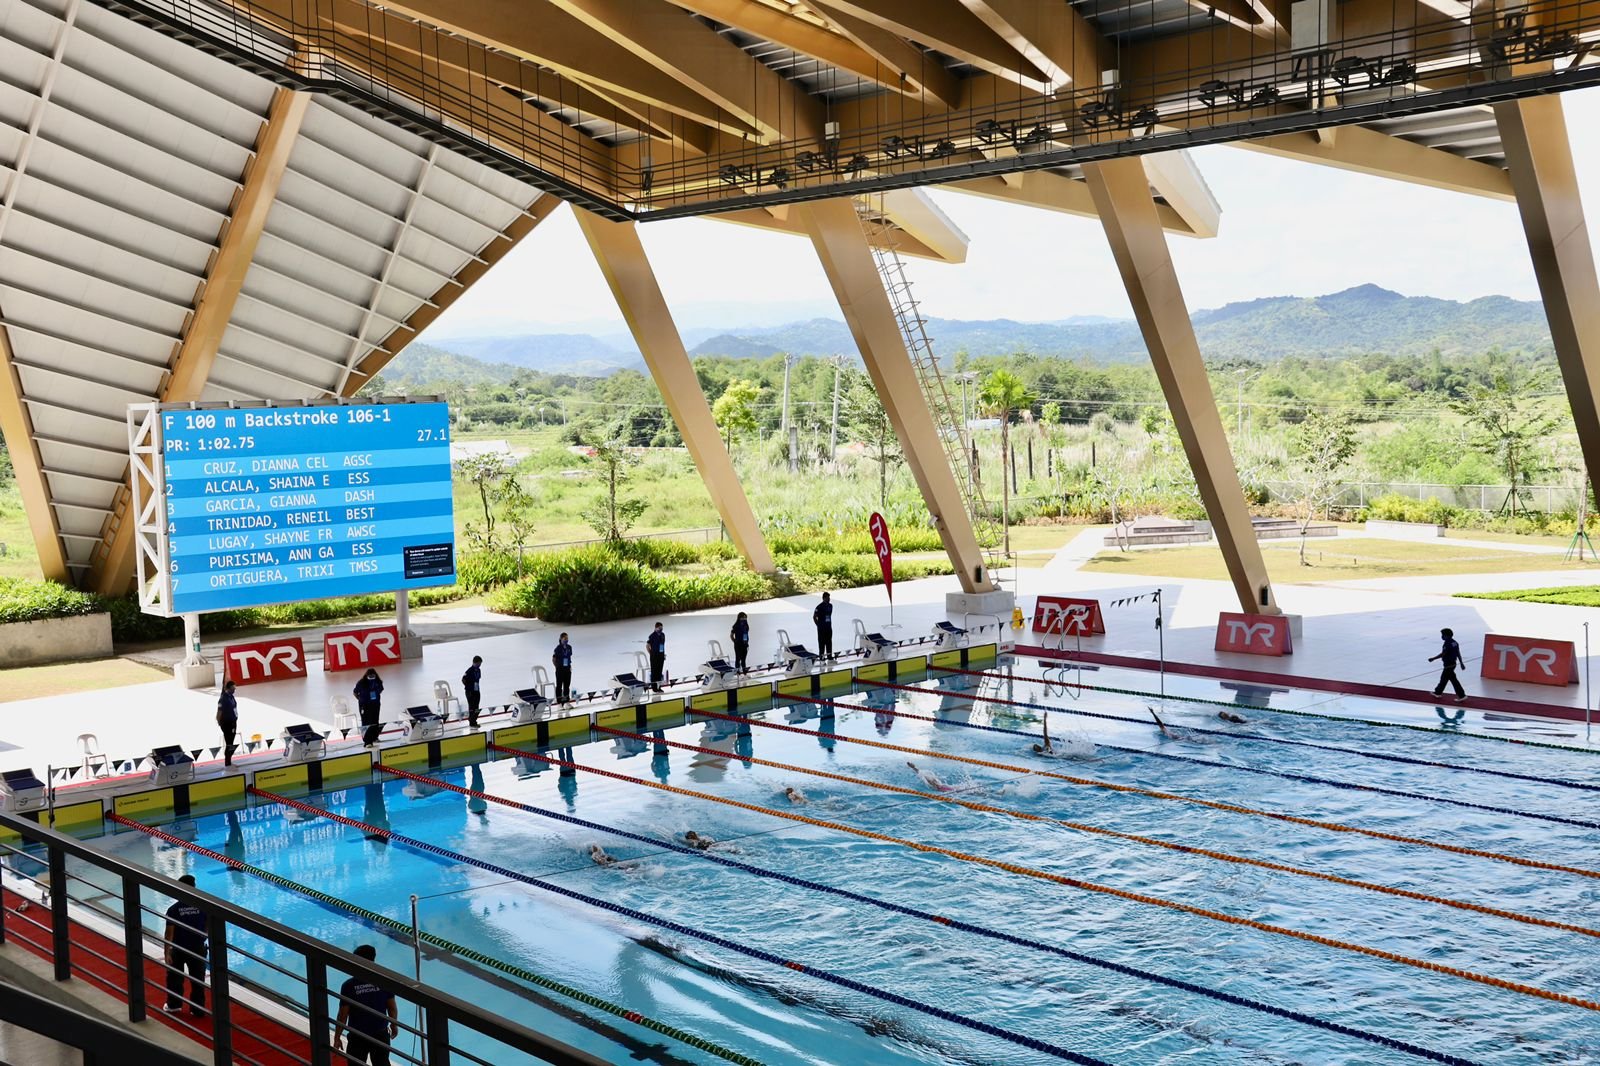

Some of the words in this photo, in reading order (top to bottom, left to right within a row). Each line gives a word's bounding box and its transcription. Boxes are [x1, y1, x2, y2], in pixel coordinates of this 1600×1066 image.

[165, 415, 175, 430] F
[185, 414, 216, 430] 100
[225, 415, 236, 428] m
[245, 410, 338, 427] Backstroke
[347, 408, 391, 423] 106-1
[166, 439, 190, 452] PR:
[198, 436, 255, 451] 1:02.75
[417, 428, 447, 442] 27.1
[164, 465, 173, 477] 1
[203, 461, 243, 476] CRUZ,
[252, 458, 300, 472] DIANNA
[306, 456, 329, 469] CEL
[343, 454, 373, 467] AGSC
[165, 484, 175, 496] 2
[205, 479, 260, 494] ALCALA,
[269, 475, 316, 490] SHAINA
[322, 474, 330, 486] E
[348, 472, 370, 485] ESS
[167, 503, 176, 515] 3
[206, 498, 261, 513] GARCIA,
[269, 493, 317, 508] GIANNA
[344, 489, 375, 503] DASH
[168, 522, 177, 534] 4
[207, 514, 278, 531] TRINIDAD,
[287, 510, 332, 525] RENEIL
[346, 507, 375, 521] BEST
[169, 541, 177, 553] 5
[209, 535, 255, 550] LUGAY,
[264, 529, 311, 546] SHAYNE
[318, 528, 333, 541] FR
[347, 524, 377, 538] AWSC
[871, 515, 889, 559] TYR
[170, 560, 179, 572] 6
[209, 551, 280, 569] PURISIMA,
[288, 548, 312, 561] ANN
[318, 546, 334, 559] GA
[352, 542, 374, 556] ESS
[172, 579, 179, 592] 7
[210, 569, 288, 588] ORTIGUERA,
[297, 564, 334, 579] TRIXI
[349, 560, 379, 574] TMSS
[1038, 602, 1090, 631] TYR
[1226, 620, 1275, 648] TYR
[230, 645, 301, 679] TYR
[328, 631, 399, 666] TYR
[1493, 643, 1556, 676] TYR
